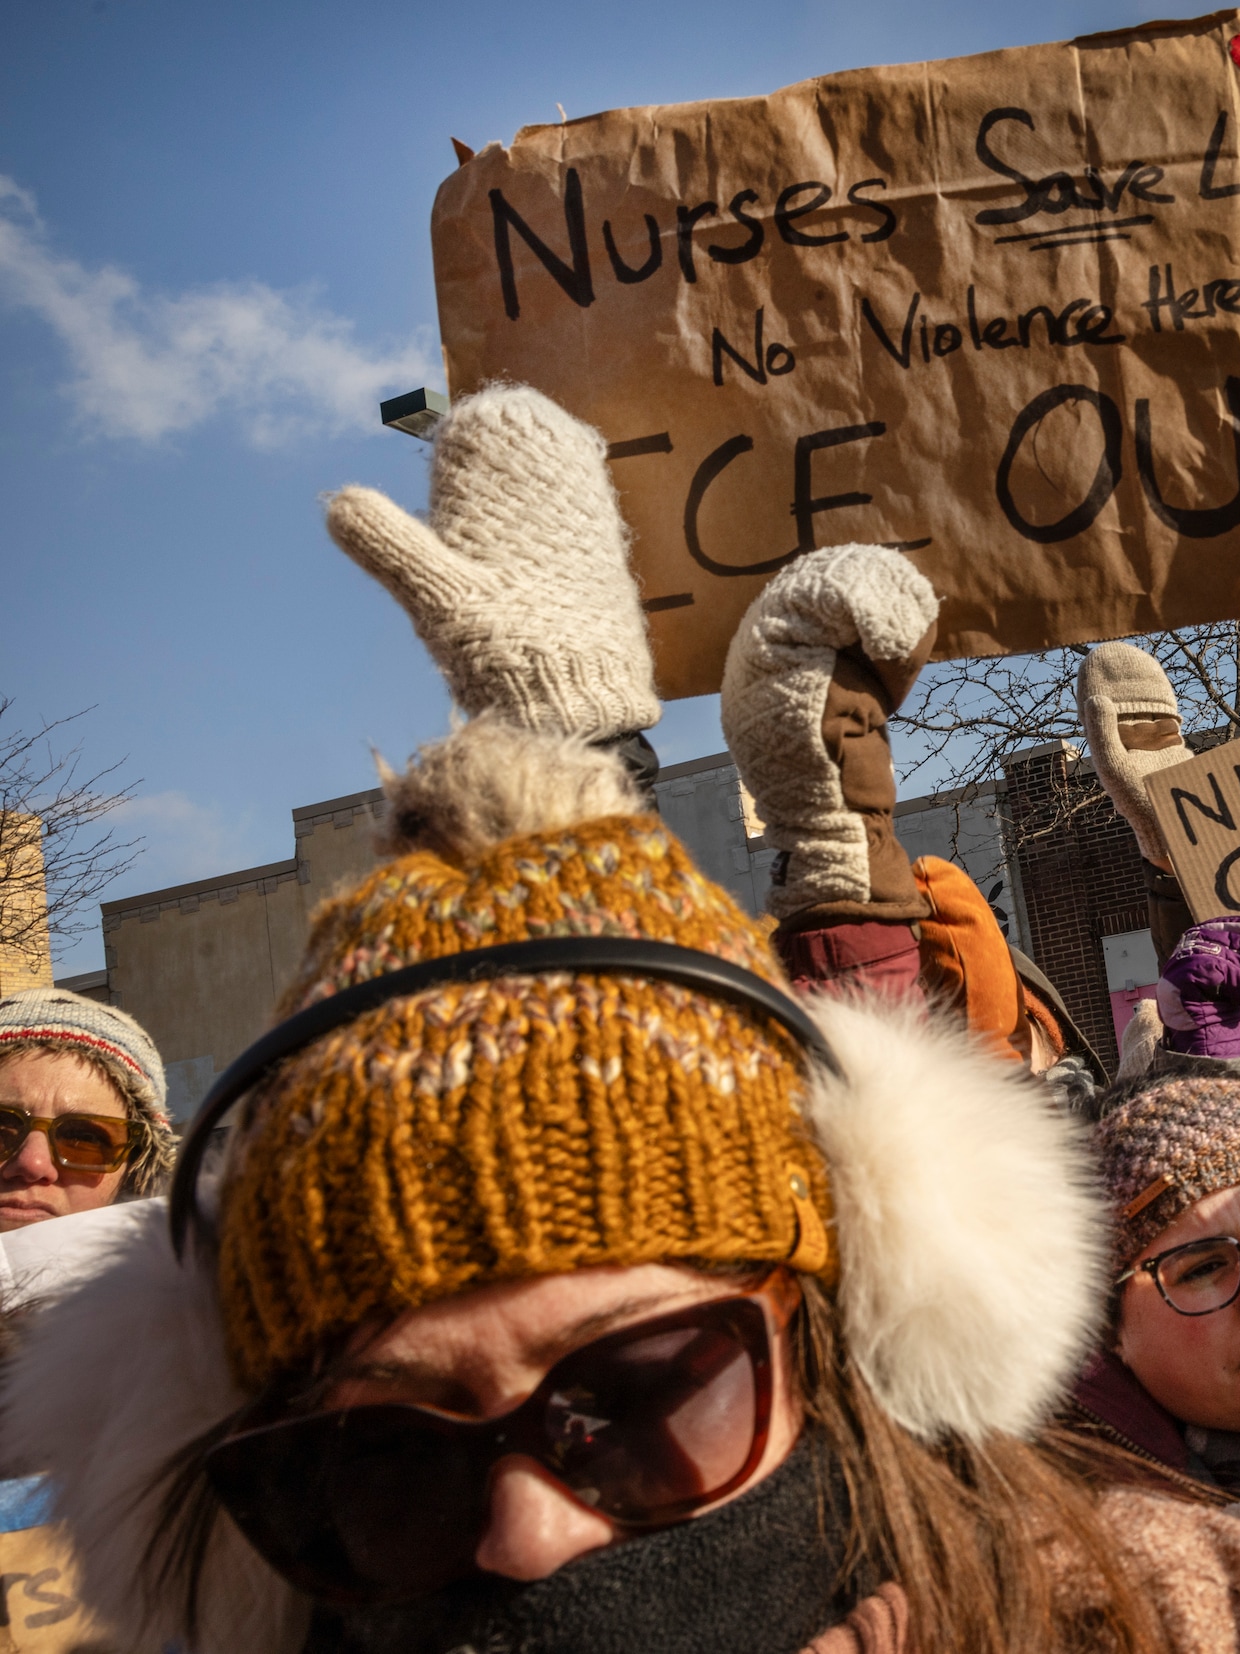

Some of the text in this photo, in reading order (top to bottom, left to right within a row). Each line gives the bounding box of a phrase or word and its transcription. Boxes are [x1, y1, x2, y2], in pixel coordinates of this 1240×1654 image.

[488, 168, 897, 321] Nurses
[976, 107, 1175, 225] Save
[713, 306, 795, 386] No
[863, 284, 1126, 370] Violence
